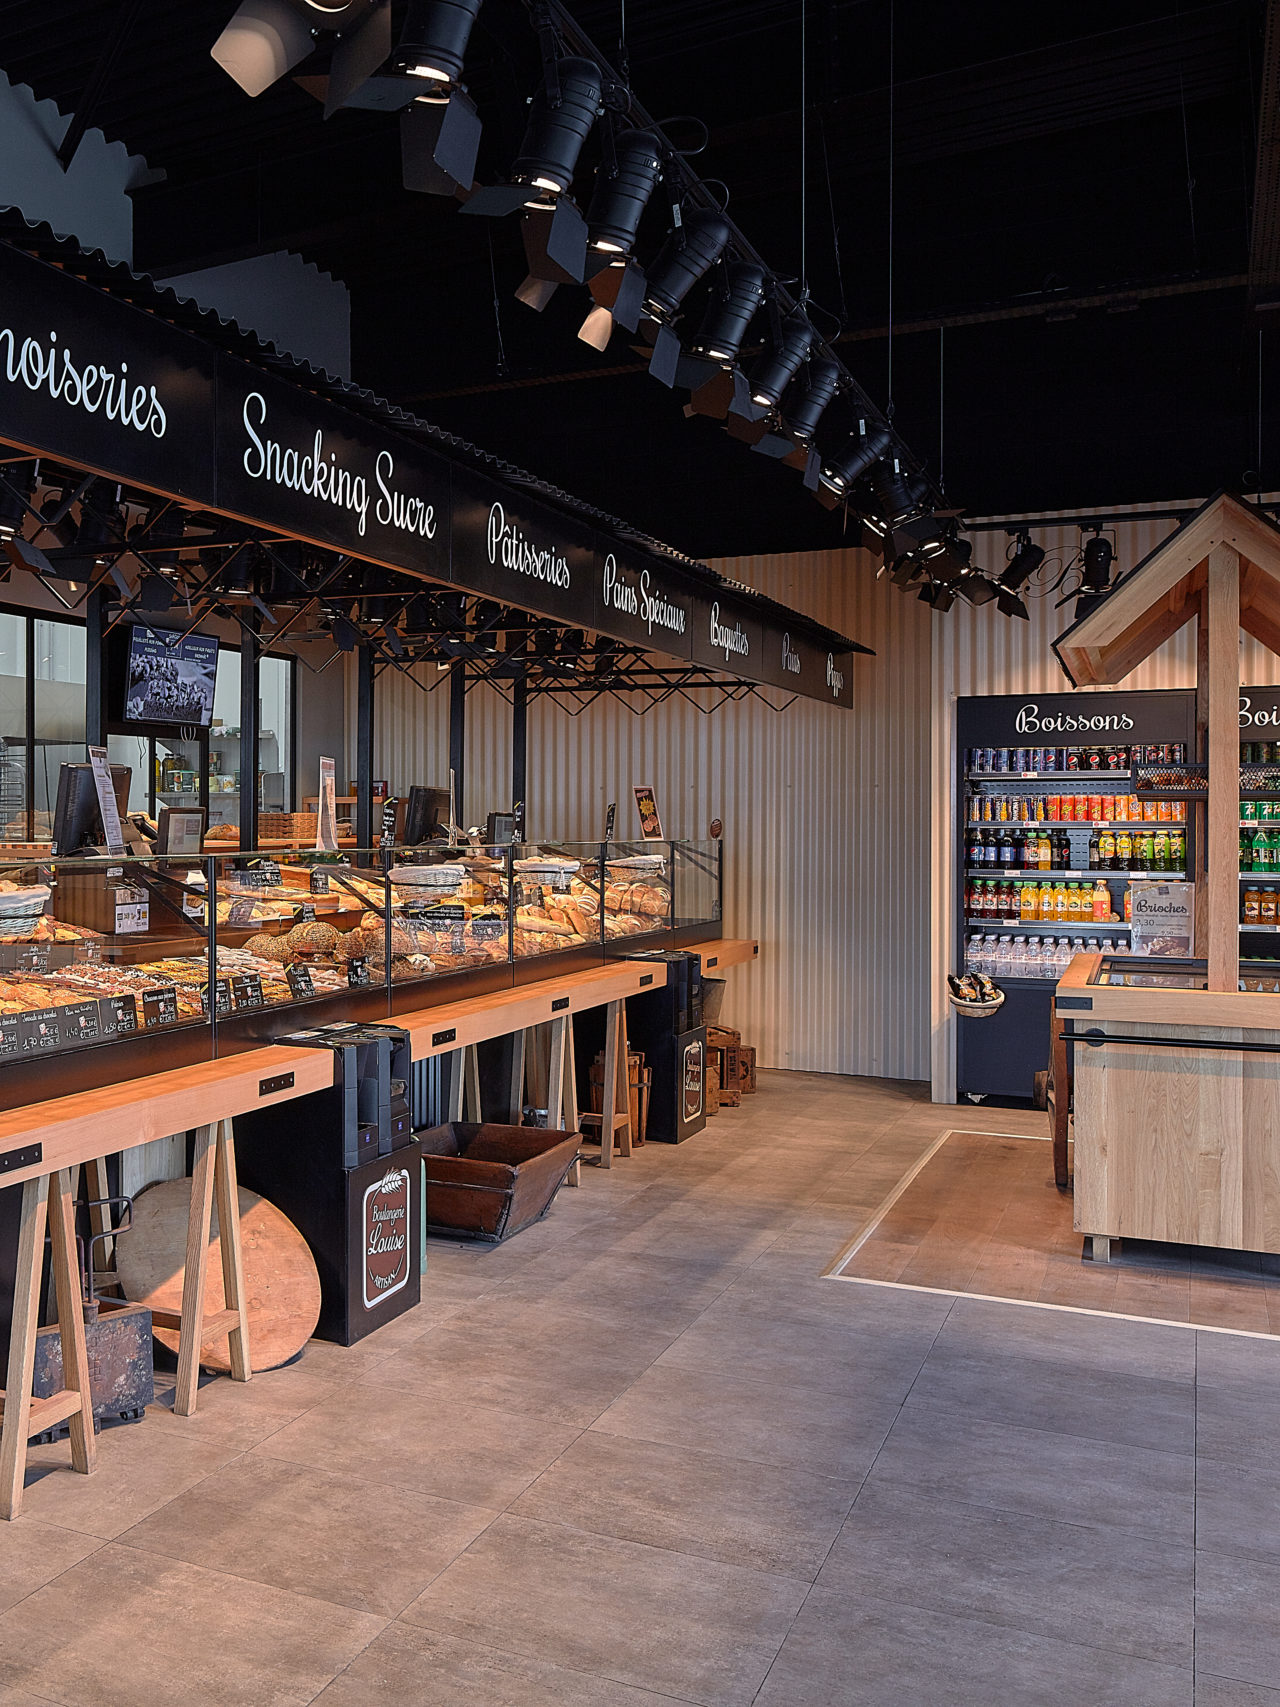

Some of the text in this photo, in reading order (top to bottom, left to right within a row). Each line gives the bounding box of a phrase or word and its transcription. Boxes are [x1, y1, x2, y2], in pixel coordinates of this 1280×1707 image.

[243, 392, 436, 539] Snacking Sucre
[488, 502, 570, 589] Pâtisseries
[603, 554, 685, 636] Pains Spéciaux
[710, 601, 749, 661] Baguettes
[782, 632, 800, 674] Pains
[1015, 704, 1134, 733] Boissons
[1136, 899, 1188, 914] Brioches
[1, 1016, 18, 1026] chocolat
[372, 1203, 405, 1226] Boulangerie
[367, 1222, 405, 1255] Louise
[373, 1269, 396, 1289] ARTISAN
